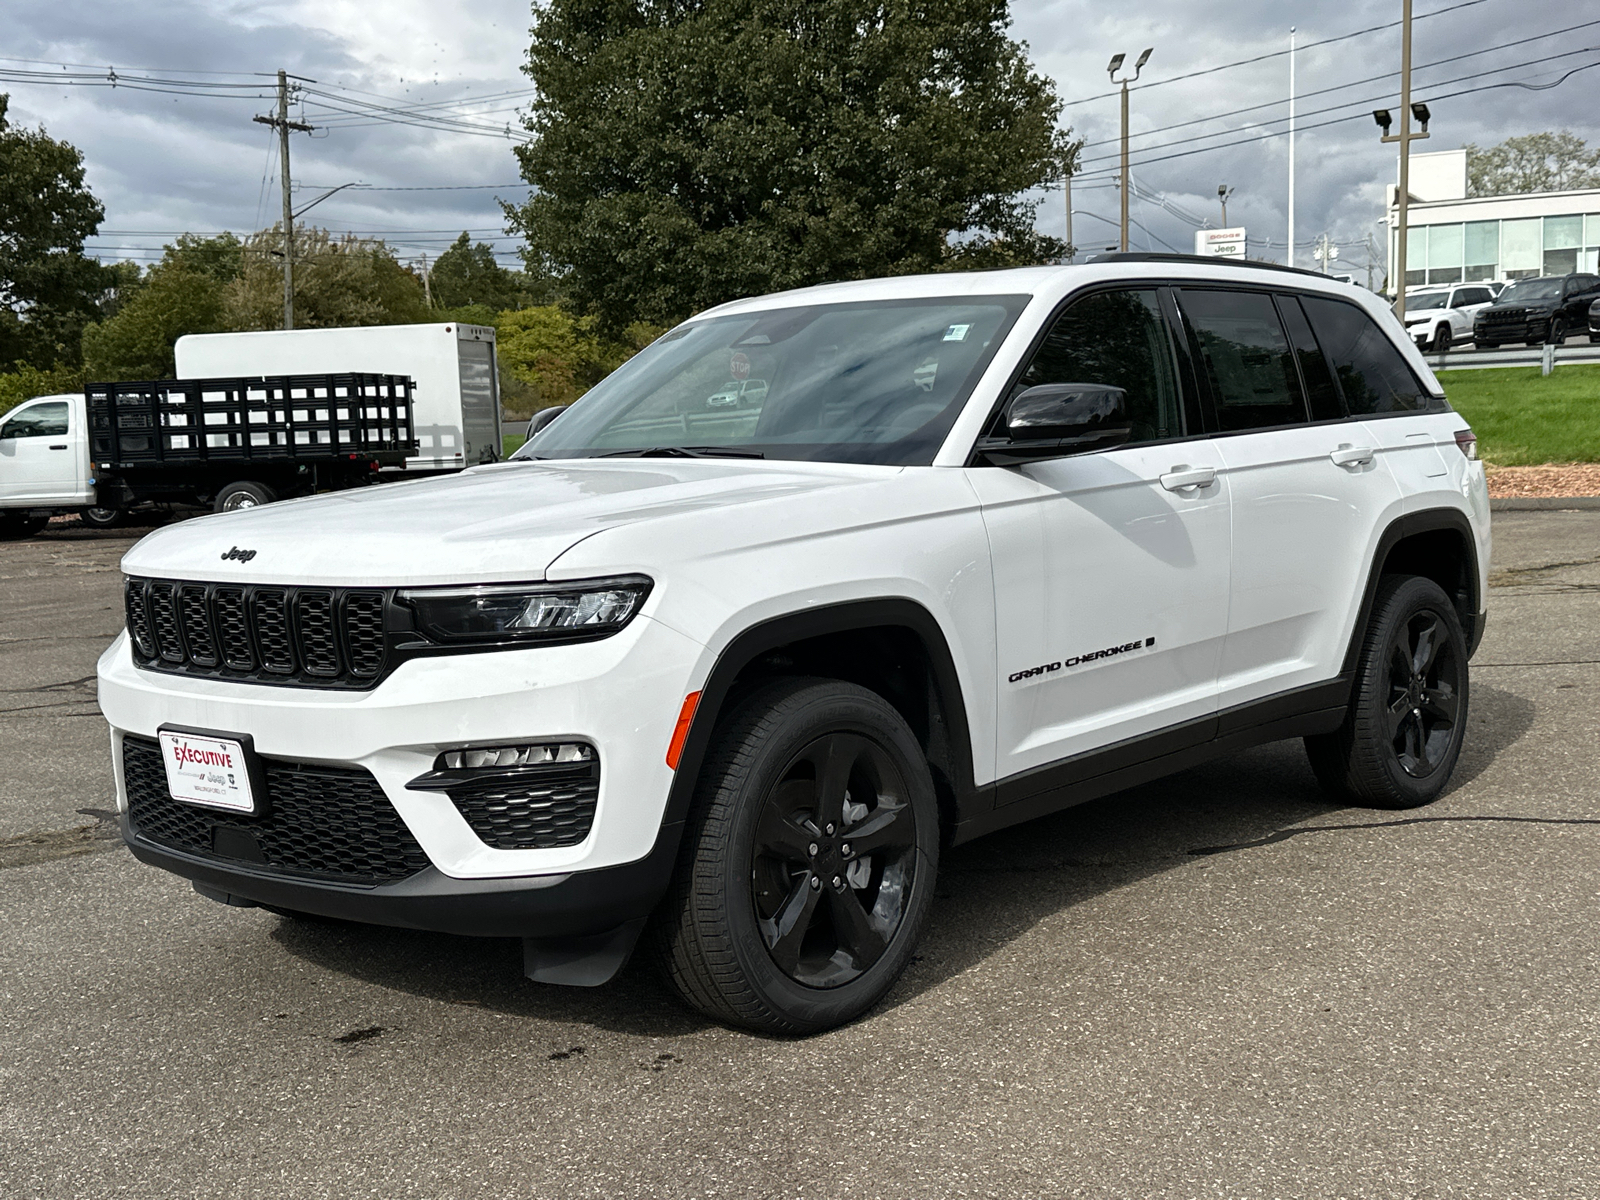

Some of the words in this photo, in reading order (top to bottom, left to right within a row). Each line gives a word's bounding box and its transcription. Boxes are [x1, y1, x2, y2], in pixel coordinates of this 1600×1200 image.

[1214, 245, 1236, 253] Jeep
[731, 361, 750, 373] STOP
[220, 546, 257, 564] Jeep
[1008, 661, 1061, 683] GRAND
[1065, 640, 1142, 667] CHEROKEE
[173, 742, 233, 769] EXECUTIVE
